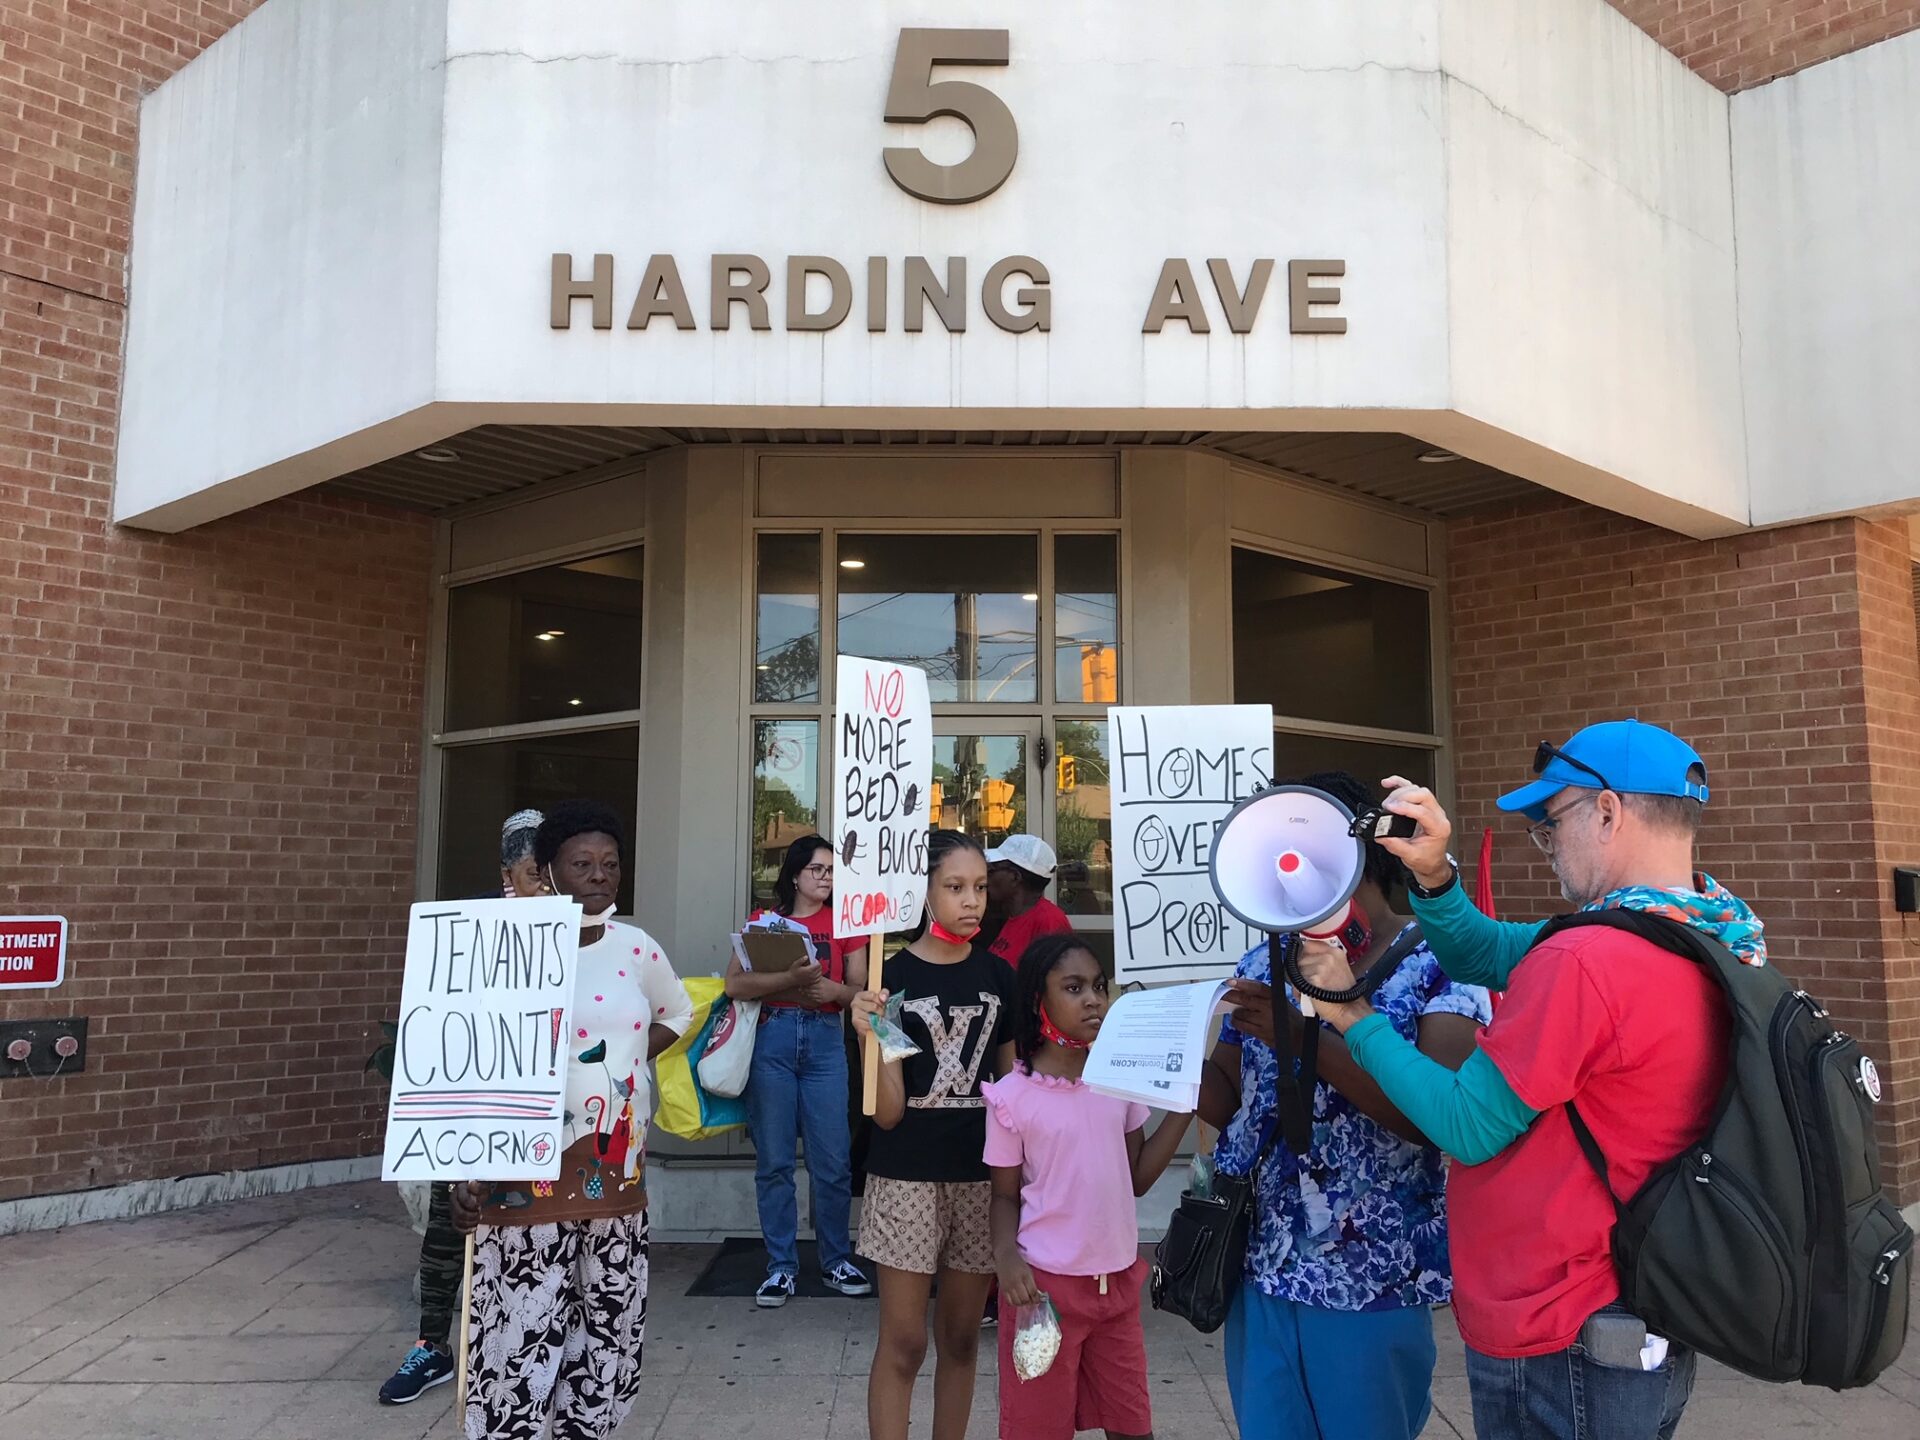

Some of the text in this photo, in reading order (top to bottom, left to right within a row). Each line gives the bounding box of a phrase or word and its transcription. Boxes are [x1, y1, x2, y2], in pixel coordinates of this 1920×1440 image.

[883, 28, 1019, 206] 5
[550, 253, 1348, 336] HARDING AVE
[864, 669, 904, 718] NO
[843, 713, 912, 772] MORE
[845, 766, 899, 822] BED
[878, 826, 930, 877] BUGS
[840, 891, 898, 933] ACORN
[419, 911, 568, 995] TENANTS
[402, 1005, 564, 1087] COUNT!
[392, 1126, 526, 1173] ACORN
